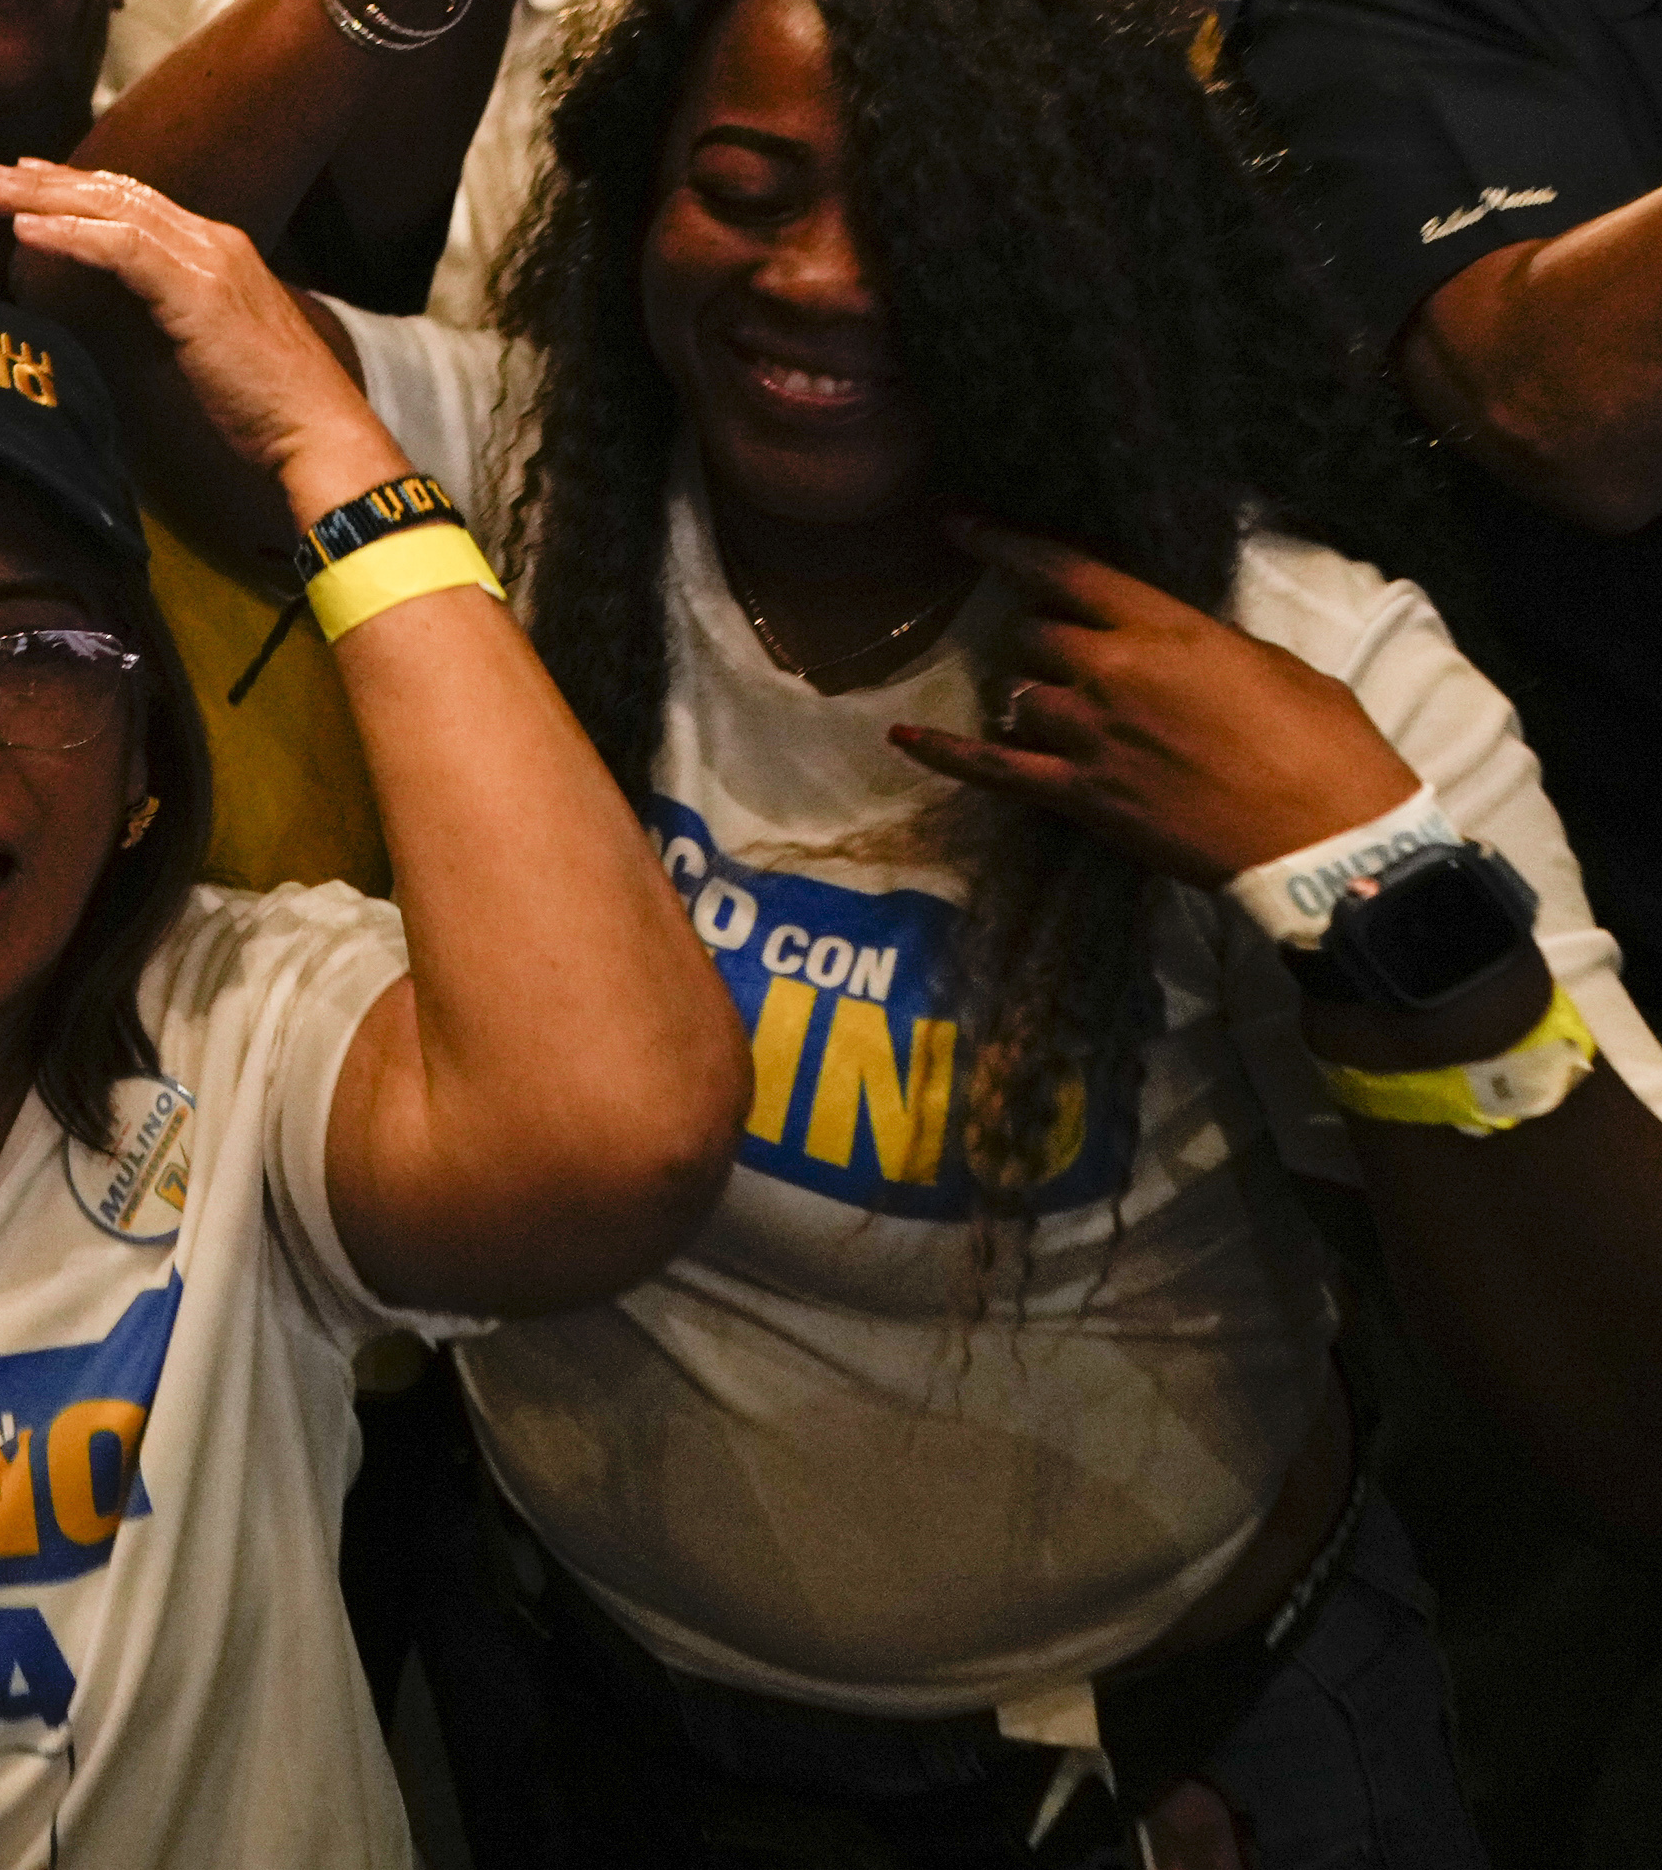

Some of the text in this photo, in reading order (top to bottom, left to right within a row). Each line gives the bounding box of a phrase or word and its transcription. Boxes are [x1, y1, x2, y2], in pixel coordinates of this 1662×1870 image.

[648, 827, 898, 1002] CO CON
[99, 1091, 174, 1223] MULINO
